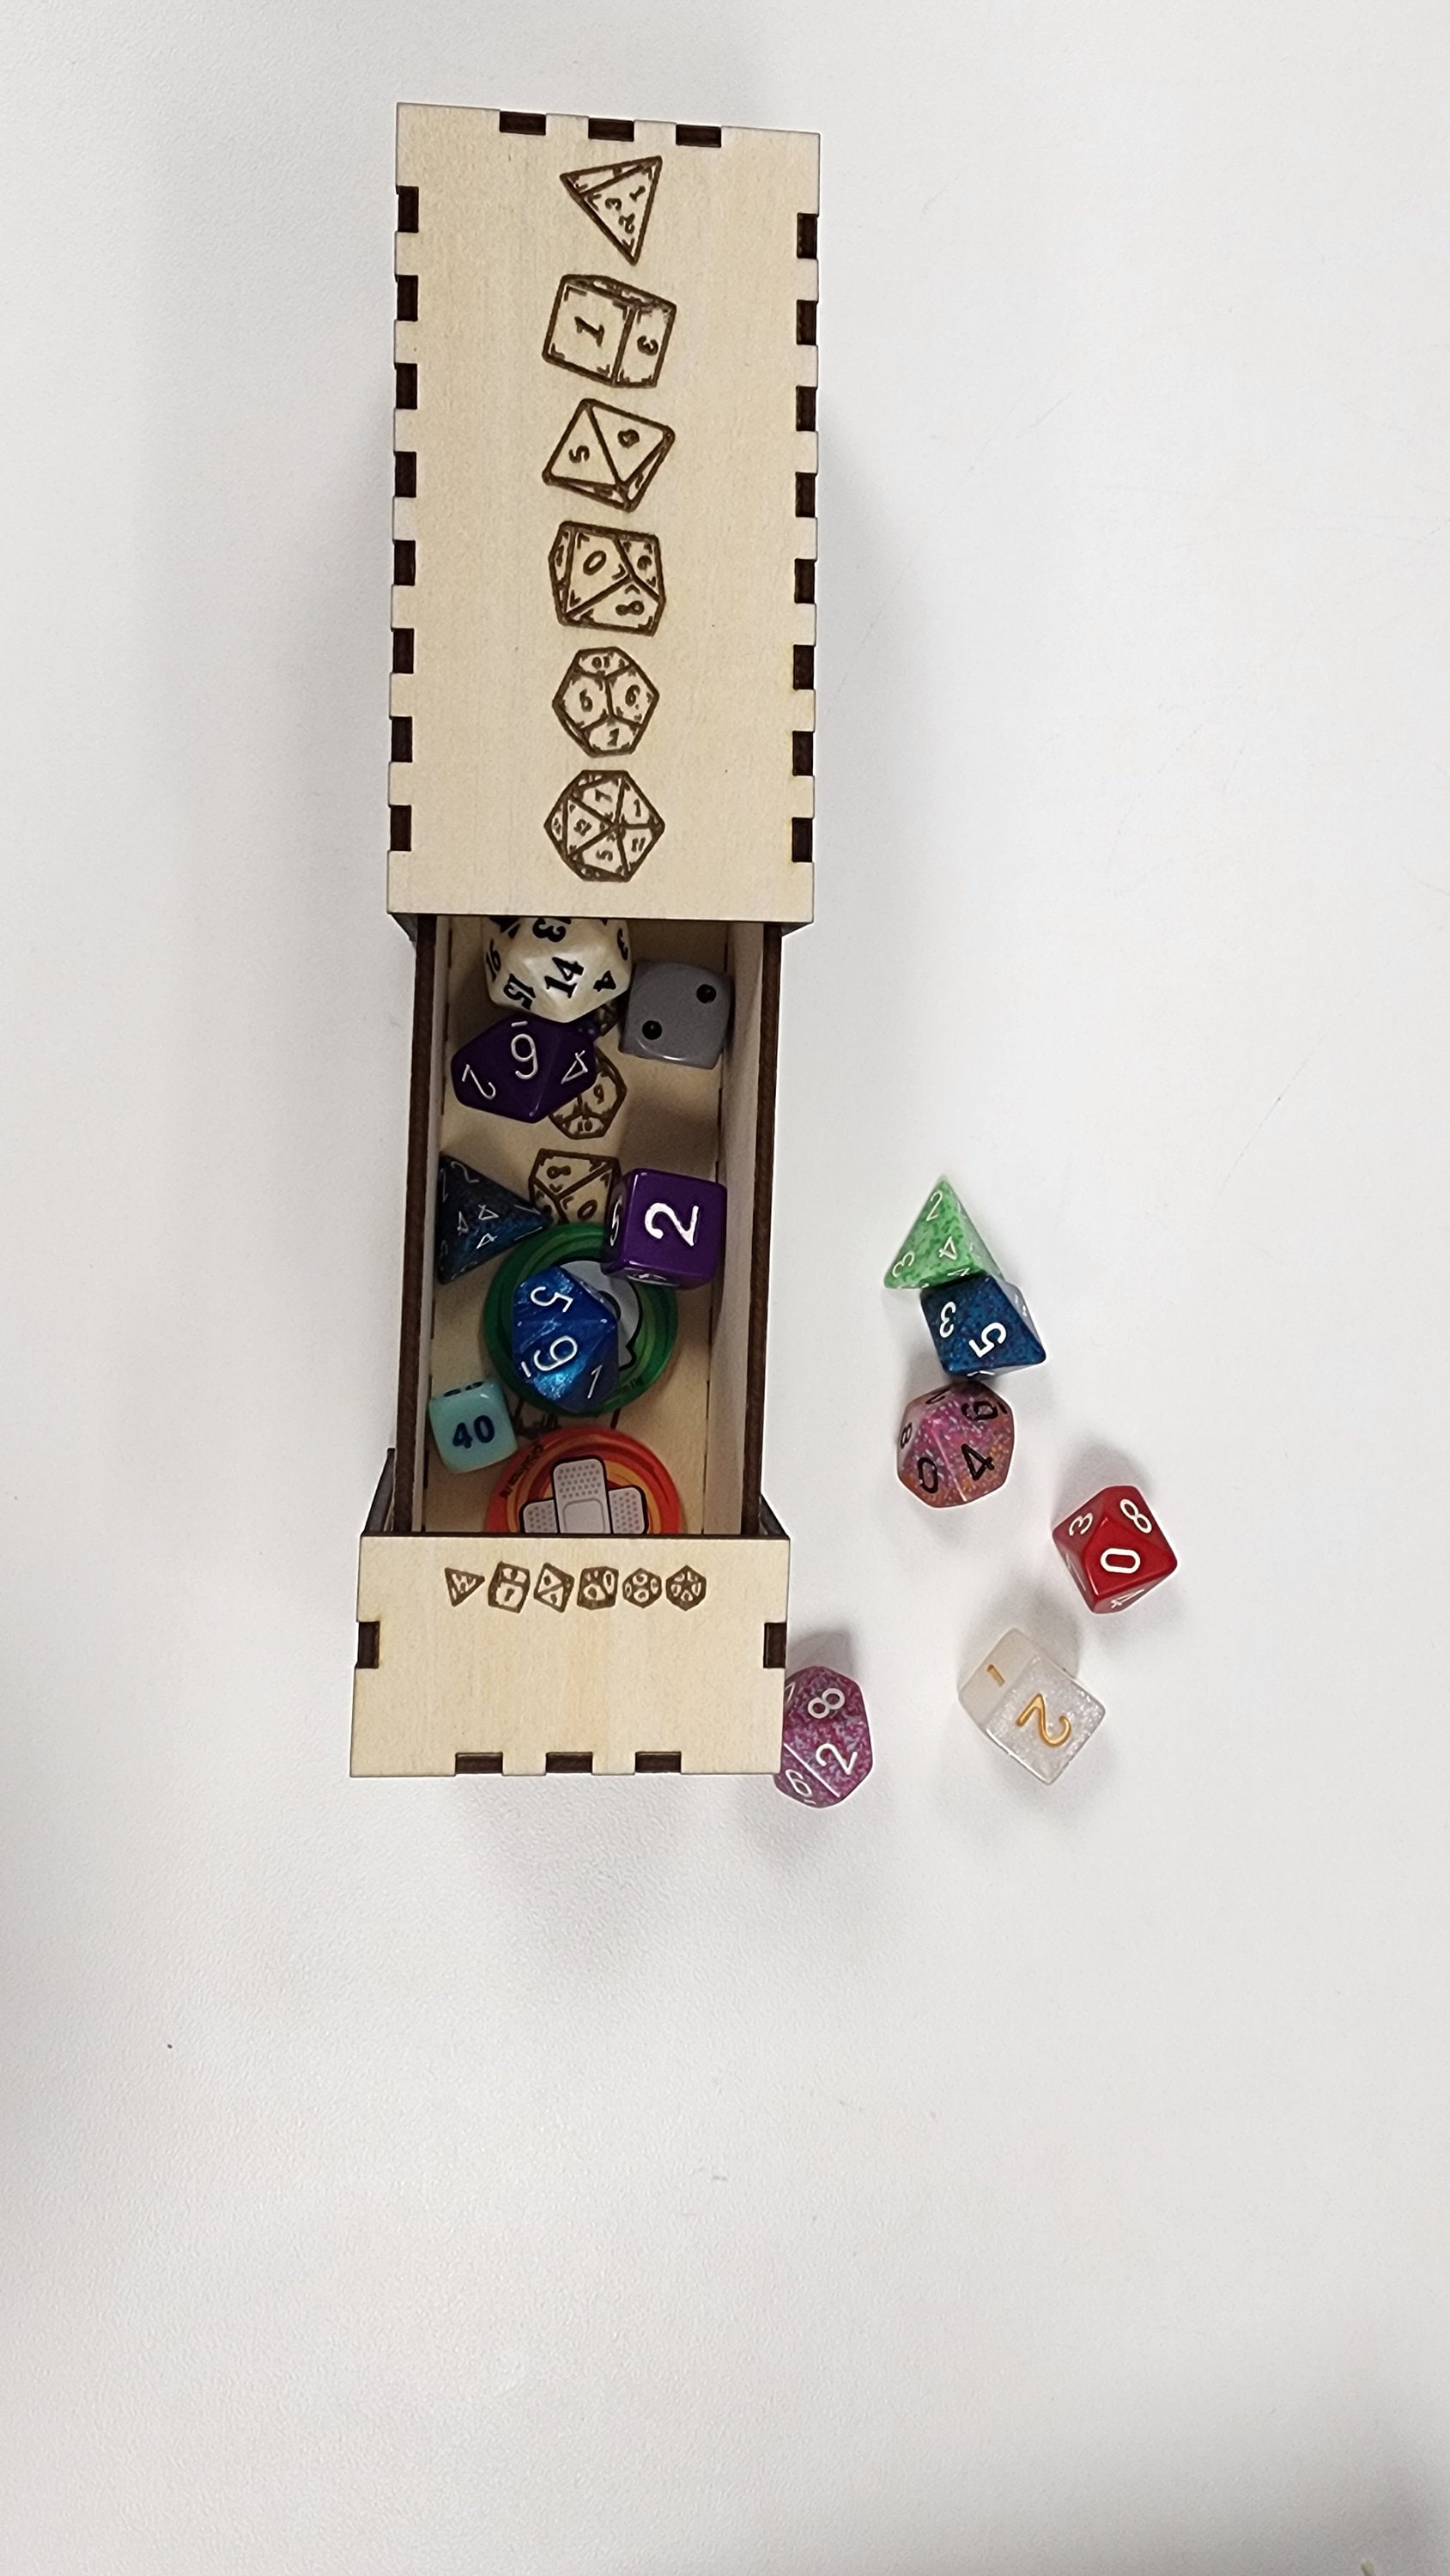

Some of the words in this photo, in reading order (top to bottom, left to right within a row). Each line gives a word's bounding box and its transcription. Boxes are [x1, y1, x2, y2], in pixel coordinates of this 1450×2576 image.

[605, 197, 622, 210] 3
[618, 213, 635, 234] 2
[574, 316, 604, 347] 1
[615, 600, 644, 616] 8
[503, 973, 536, 1010] 15
[544, 957, 585, 999] 14
[593, 969, 616, 992] 4
[462, 1064, 496, 1100] 2
[561, 1050, 588, 1084] 4
[478, 1204, 500, 1221] 4
[925, 1189, 943, 1222] 2
[645, 1202, 700, 1247] 2
[938, 1235, 959, 1261] 4
[892, 1250, 915, 1279] 3
[530, 1285, 574, 1313] 5
[939, 1301, 957, 1339] 3
[968, 1321, 1008, 1358] 5
[452, 1415, 494, 1449] 40
[917, 1457, 938, 1493] 0
[961, 1443, 995, 1481] 4
[1069, 1512, 1094, 1536] 3
[1119, 1499, 1152, 1534] 8
[1100, 1547, 1141, 1574] 0
[808, 1688, 845, 1719] 8
[1016, 1693, 1071, 1747] 2
[816, 1743, 858, 1775] 2
[786, 1769, 814, 1797] 6
